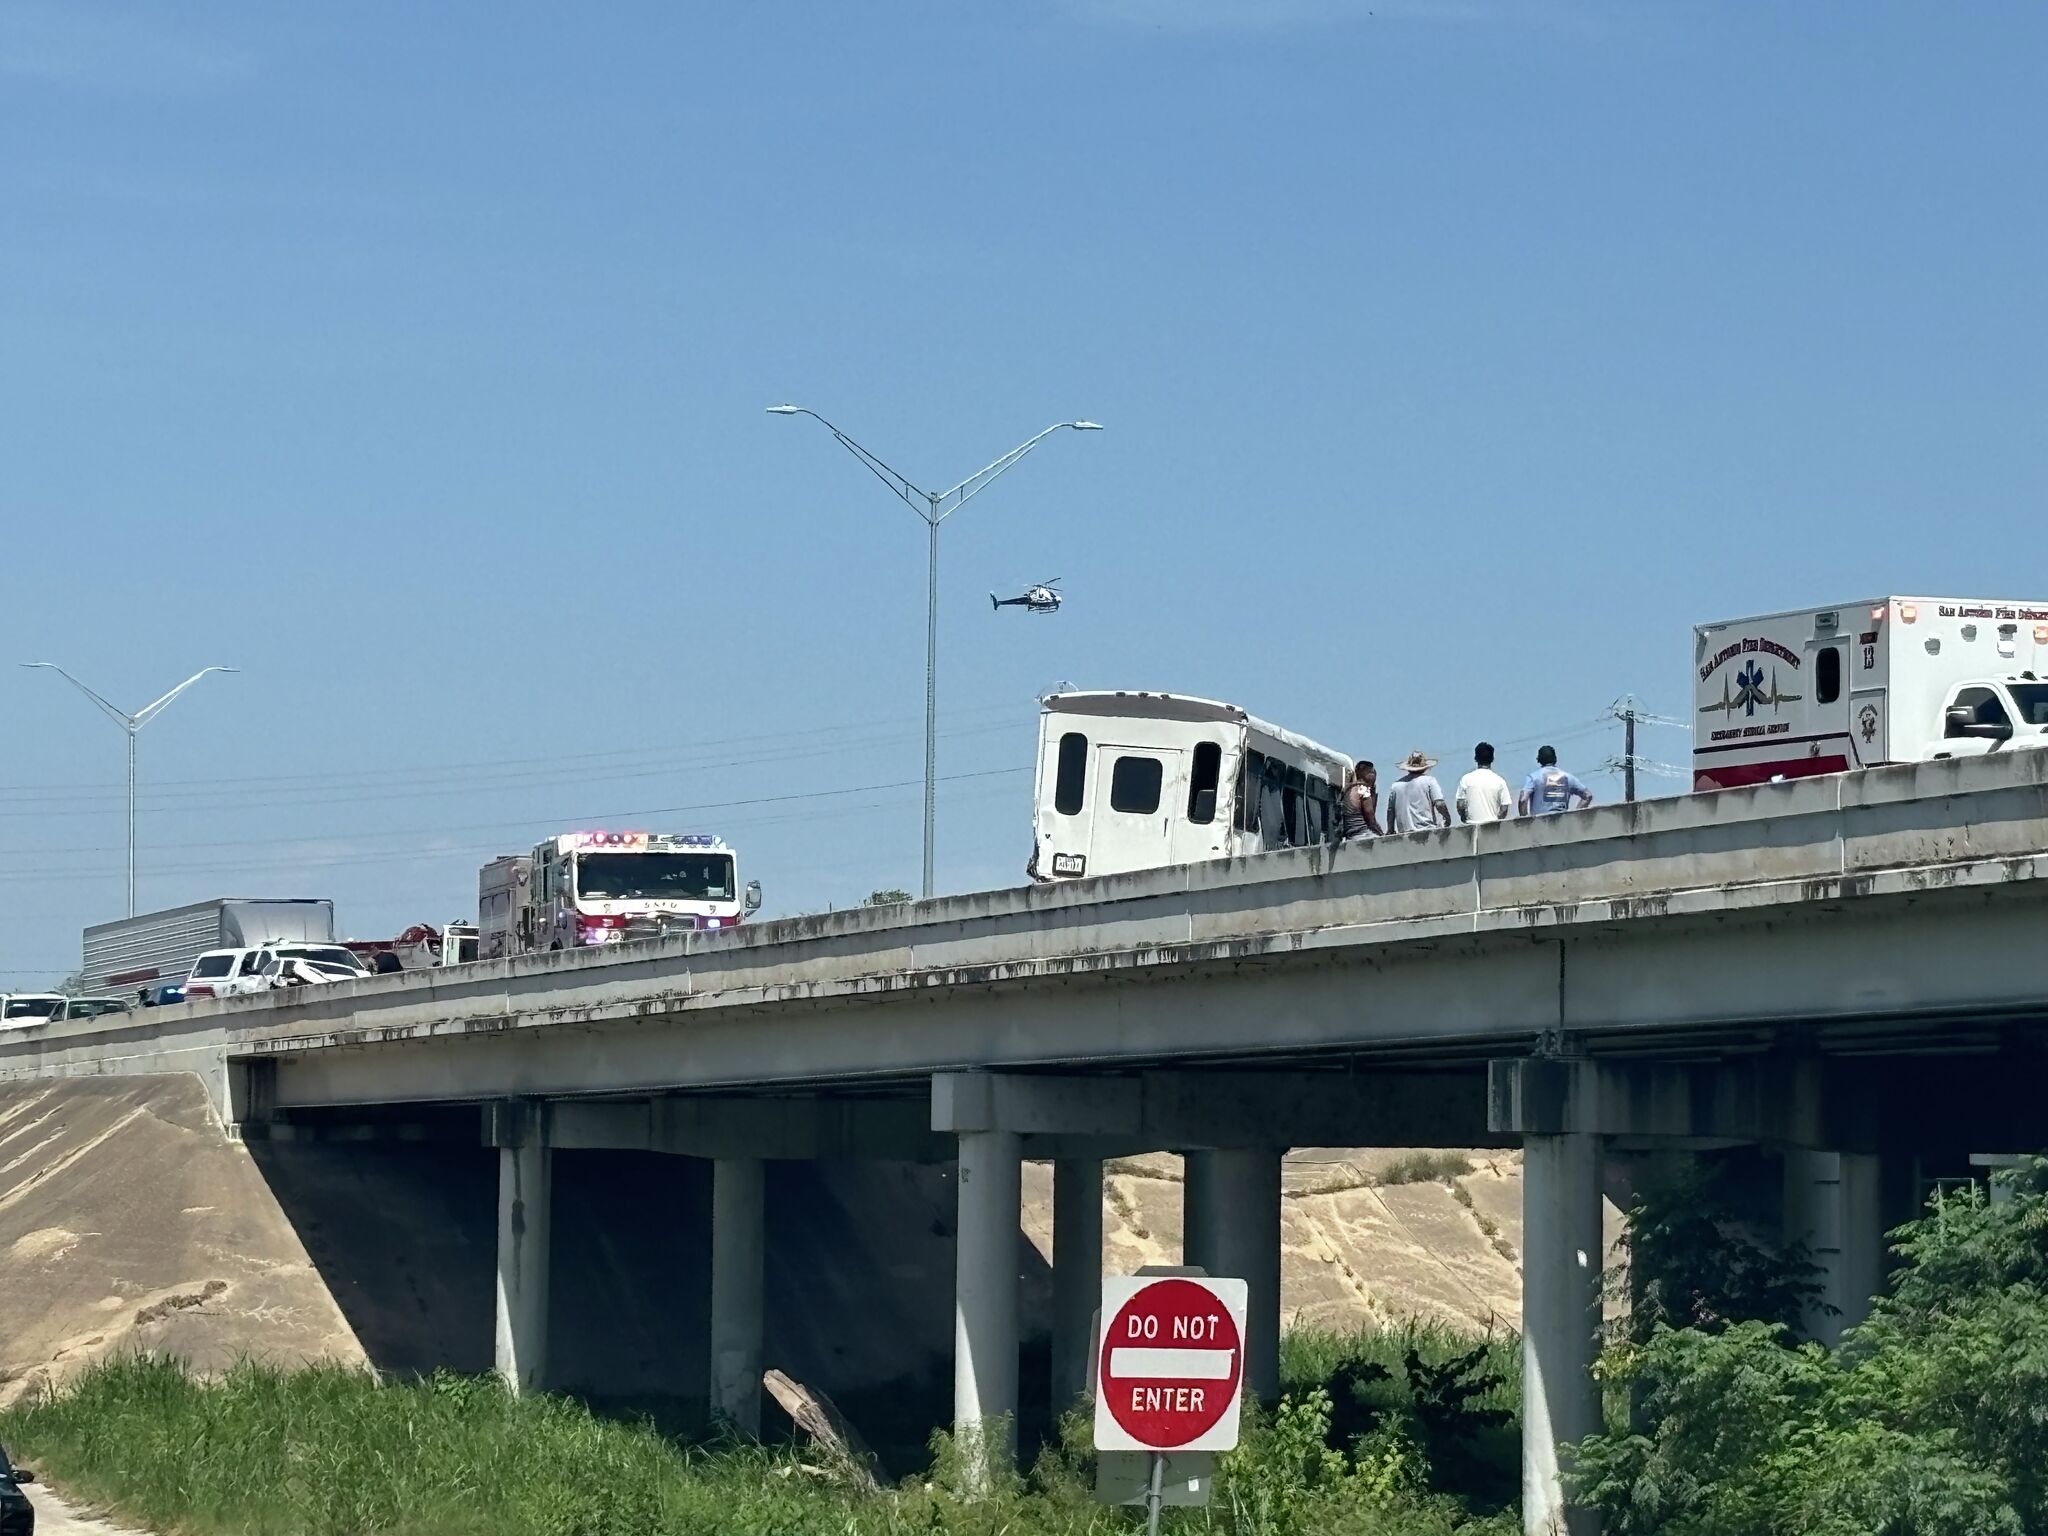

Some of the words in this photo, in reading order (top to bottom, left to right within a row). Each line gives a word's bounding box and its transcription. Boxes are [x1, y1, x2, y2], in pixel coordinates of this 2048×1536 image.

[1128, 1315, 1158, 1339] DO
[1173, 1314, 1218, 1340] NOT
[1131, 1388, 1204, 1412] ENTER
